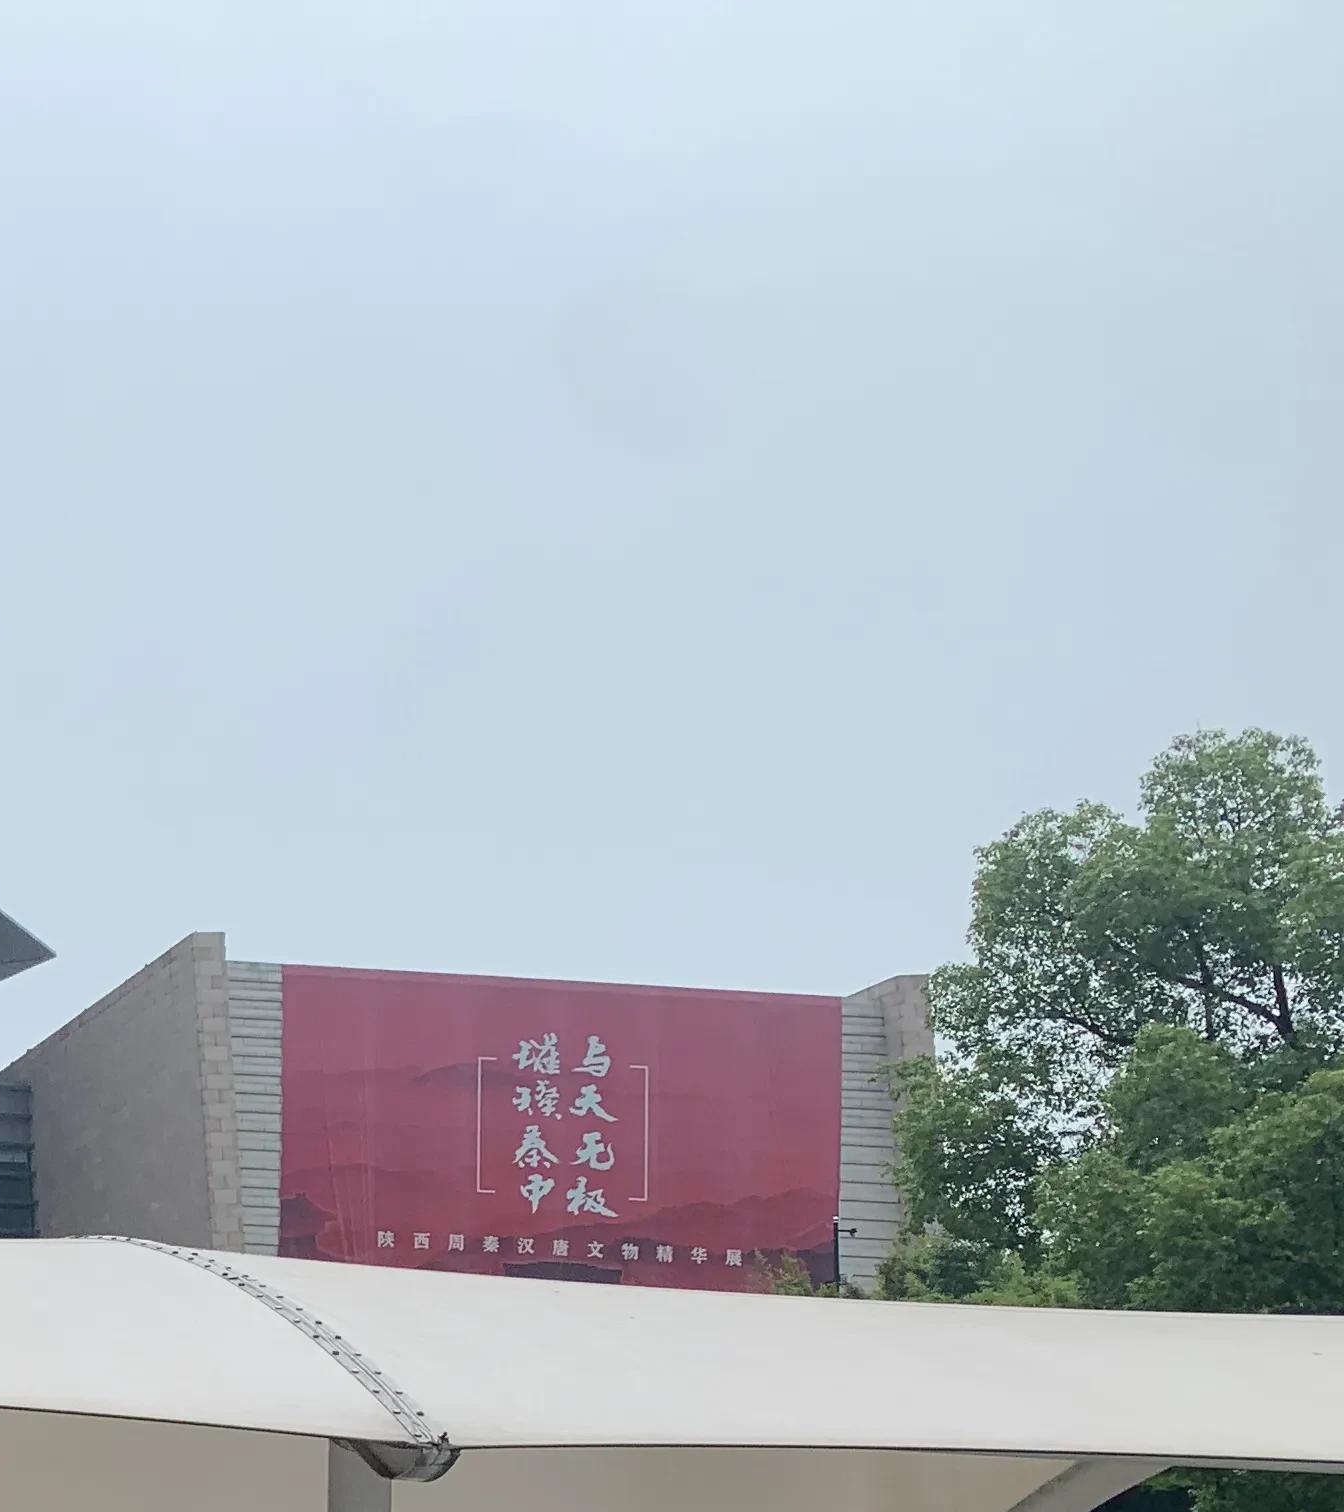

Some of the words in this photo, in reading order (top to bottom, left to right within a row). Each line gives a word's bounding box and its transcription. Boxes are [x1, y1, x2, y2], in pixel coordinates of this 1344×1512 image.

[566, 1035, 619, 1218] 与天无极
[377, 1230, 743, 1267] 陕西周秦汉唐文物精华展
